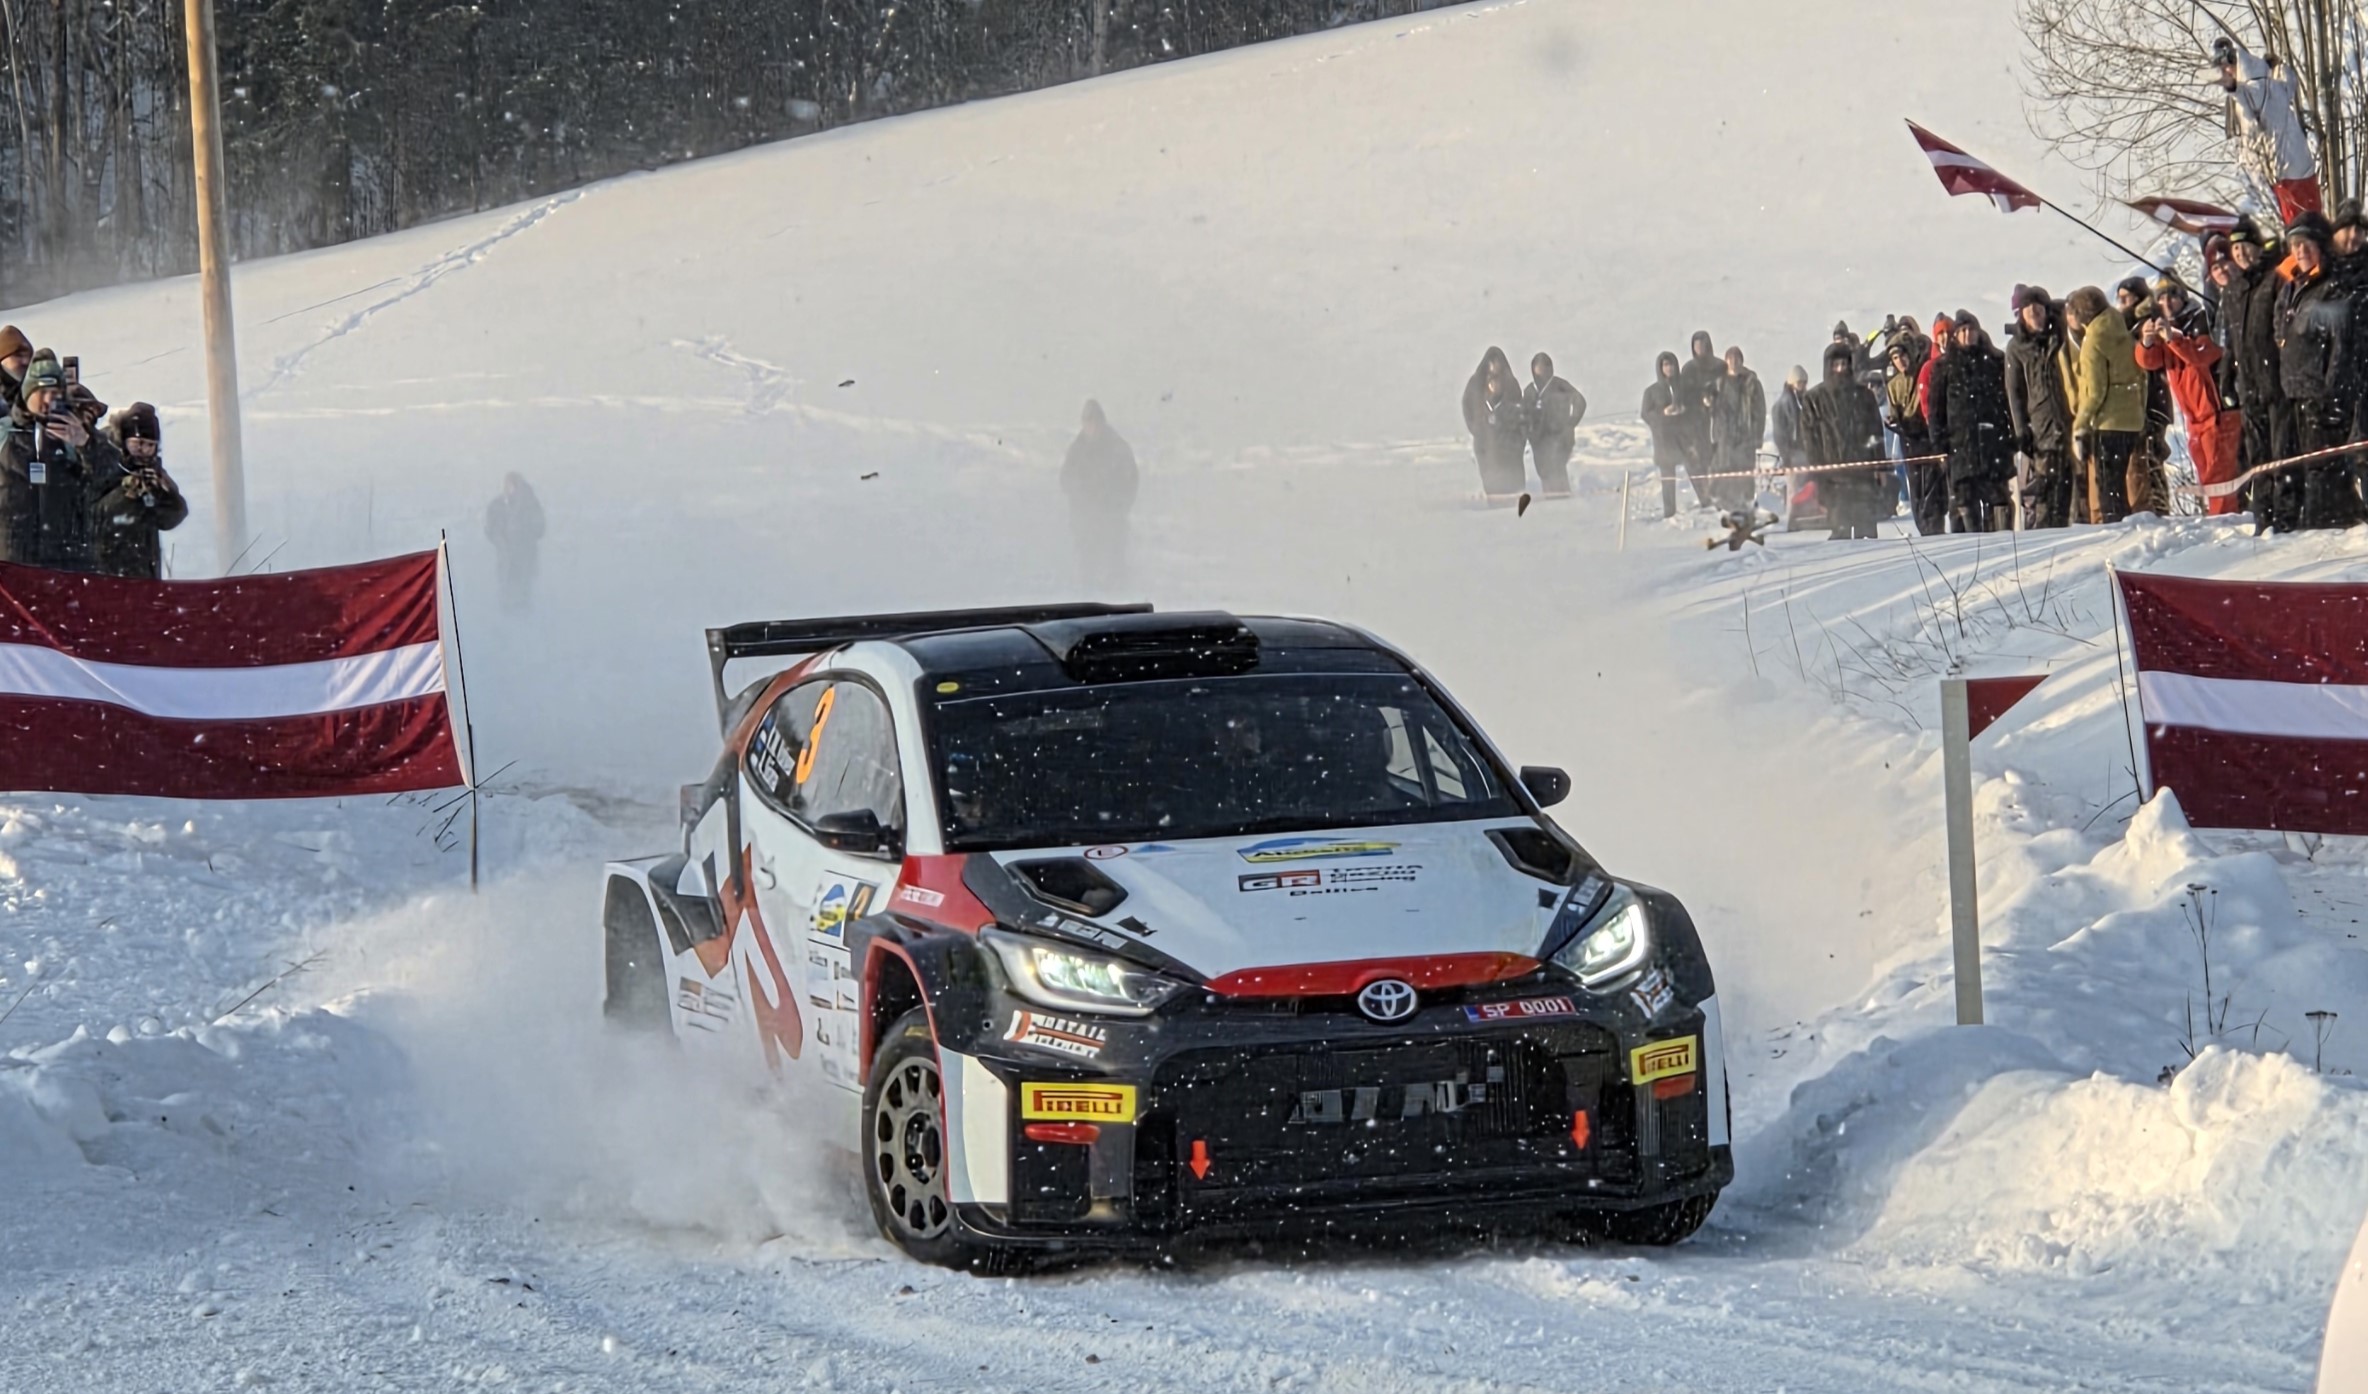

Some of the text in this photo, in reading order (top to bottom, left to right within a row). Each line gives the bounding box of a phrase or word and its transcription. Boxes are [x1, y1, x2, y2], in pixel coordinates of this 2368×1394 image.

[797, 686, 836, 785] 3
[1482, 998, 1569, 1019] SP 0001
[1032, 1089, 1123, 1114] PIRELLI
